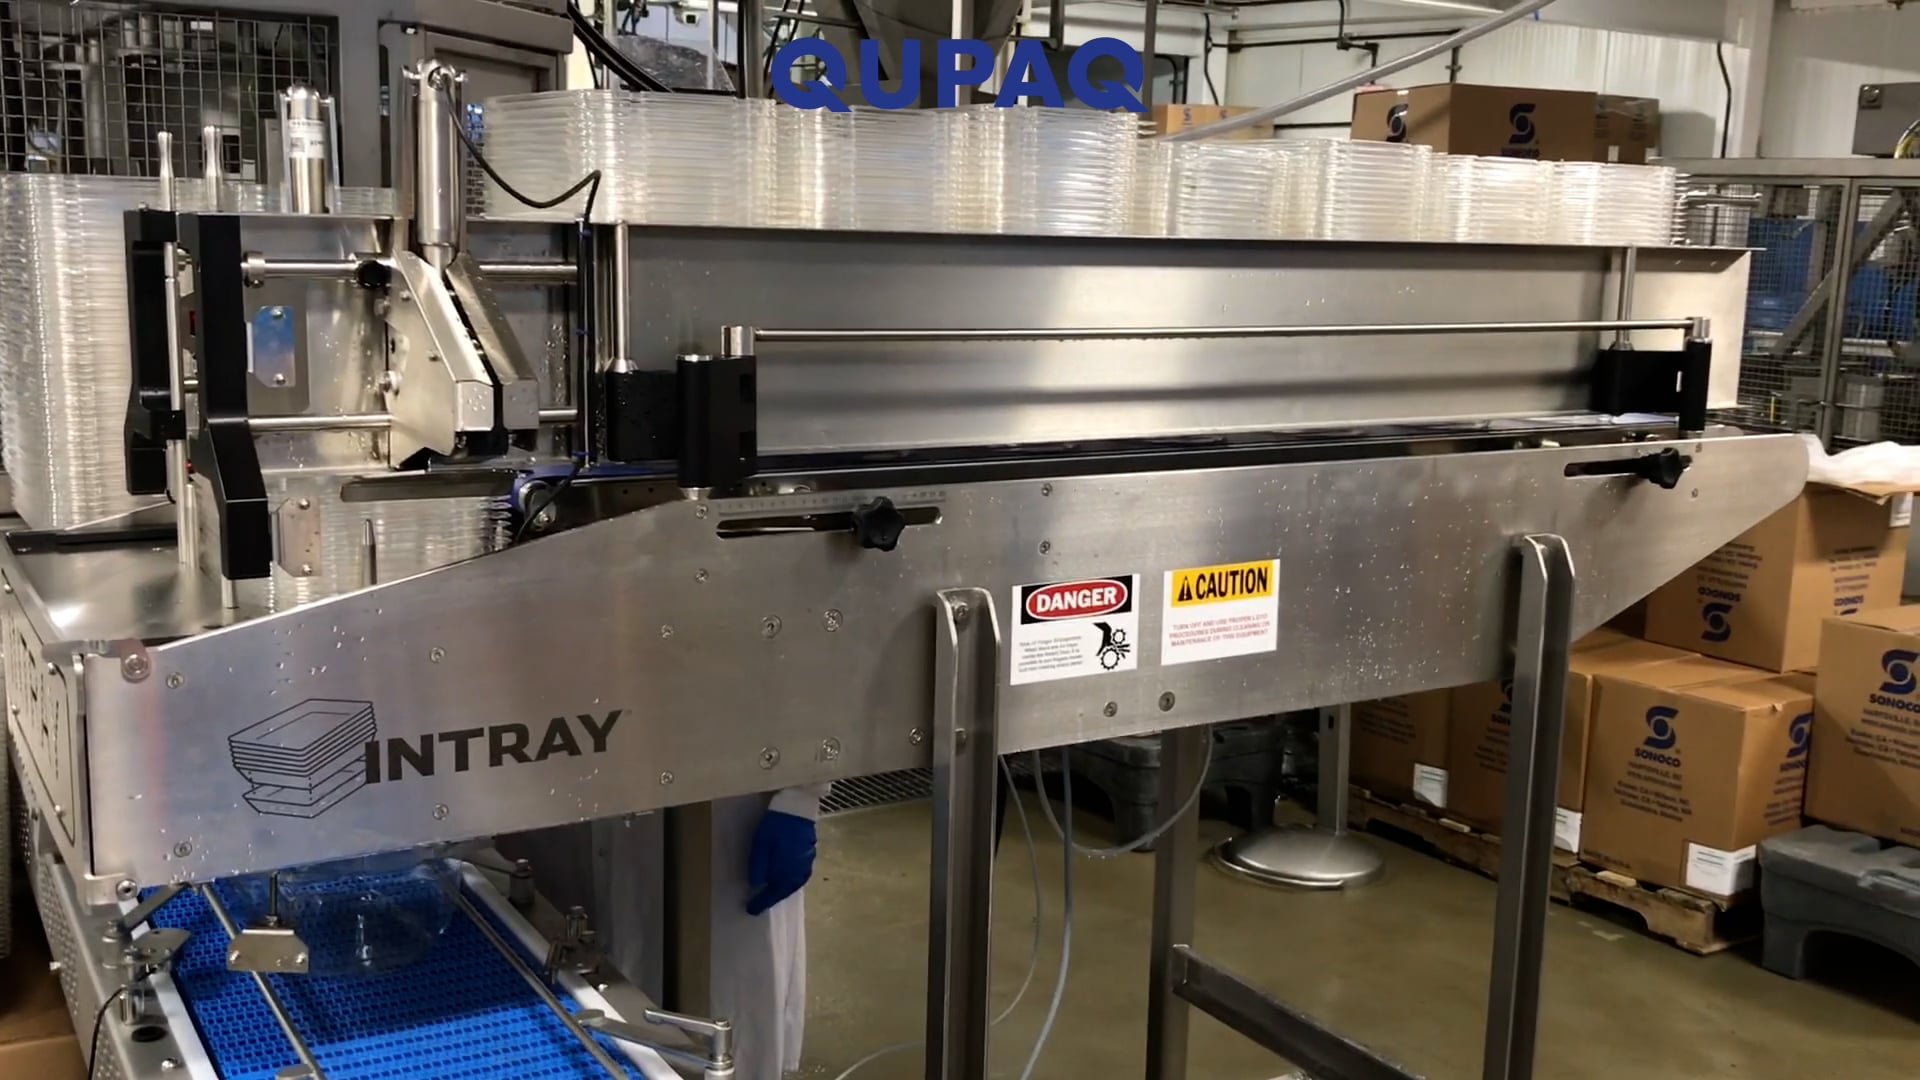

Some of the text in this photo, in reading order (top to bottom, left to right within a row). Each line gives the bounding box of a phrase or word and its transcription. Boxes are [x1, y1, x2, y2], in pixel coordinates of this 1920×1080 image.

[1195, 567, 1268, 599] CAUTION
[1036, 587, 1117, 613] DANGER
[1869, 693, 1920, 713] SONOCO
[365, 709, 623, 784] INTRAY
[1634, 747, 1681, 768] SONOCO
